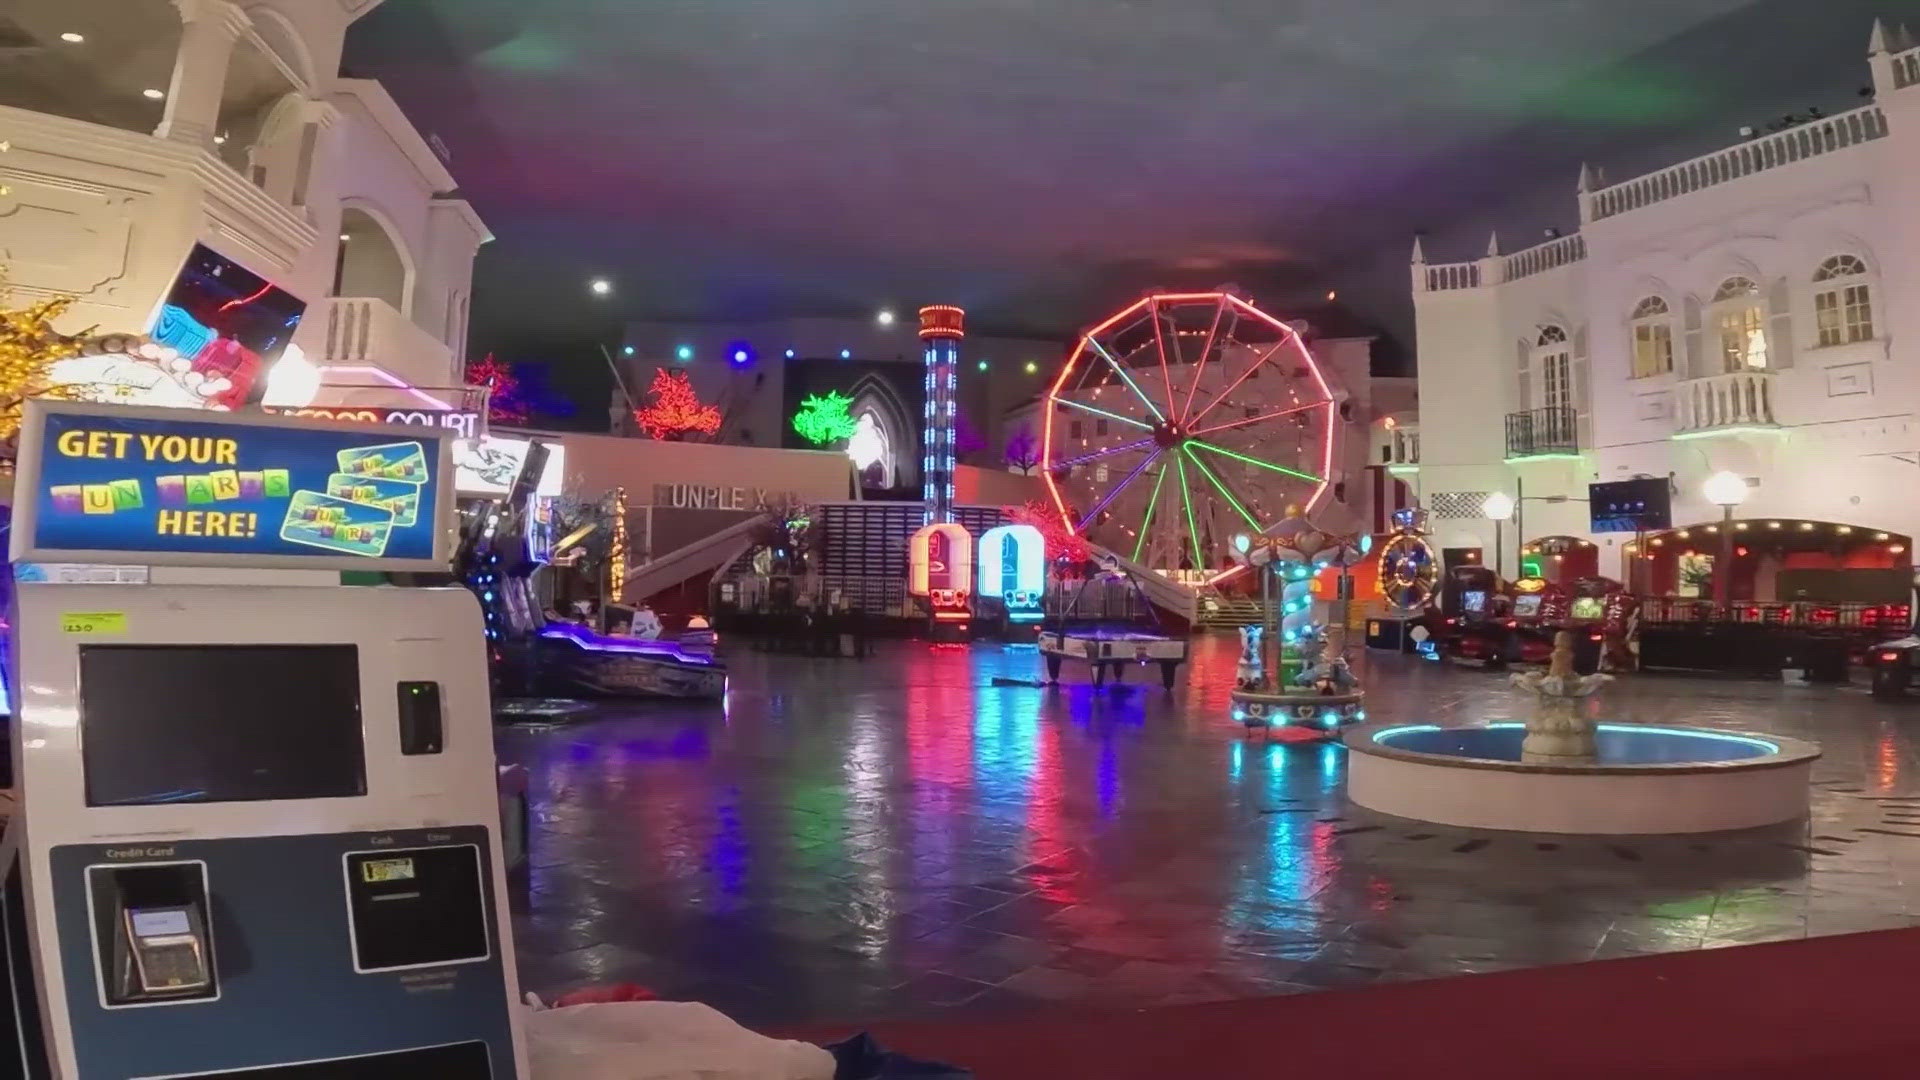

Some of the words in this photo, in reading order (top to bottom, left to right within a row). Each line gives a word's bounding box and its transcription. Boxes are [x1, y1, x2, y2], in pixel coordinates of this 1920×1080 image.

[57, 430, 133, 458] GET
[140, 434, 237, 464] YOUR
[51, 479, 143, 515] UN
[156, 469, 289, 505] ARS
[158, 510, 257, 537] HERE!
[106, 848, 143, 858] Credit
[146, 847, 174, 856] Card
